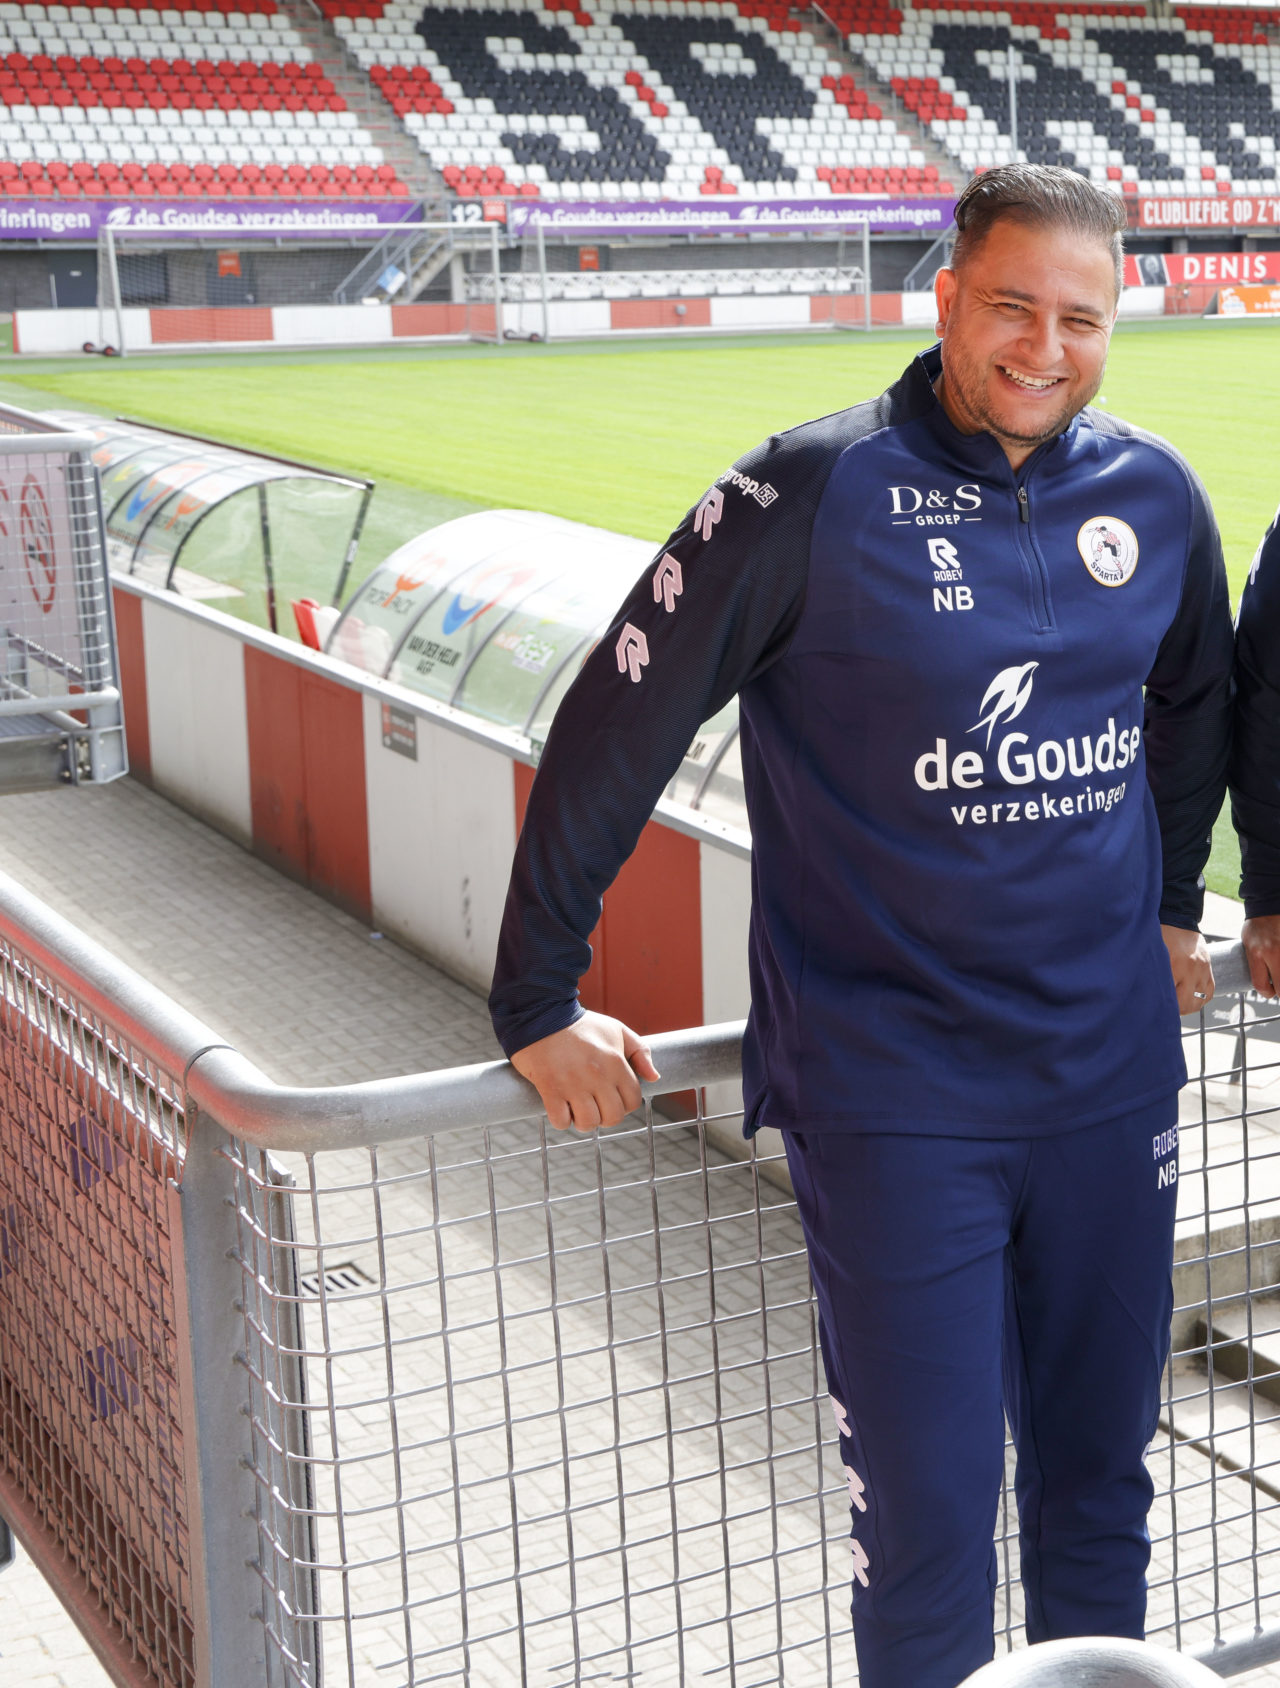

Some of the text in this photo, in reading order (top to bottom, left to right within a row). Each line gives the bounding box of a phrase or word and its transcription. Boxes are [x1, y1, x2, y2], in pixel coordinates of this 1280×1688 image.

[134, 208, 160, 226] de
[162, 208, 238, 225] Goudse
[453, 203, 482, 223] 12
[1143, 200, 1229, 225] CLUBLIEFDE
[1233, 200, 1253, 224] OP
[1183, 254, 1267, 281] DENIS
[887, 484, 982, 515] D&S
[915, 514, 961, 526] GROEP
[933, 568, 963, 582] ROBEY
[1090, 561, 1119, 582] SPARTA
[932, 585, 975, 612] NB
[914, 717, 1140, 791] de Goudse
[950, 781, 1126, 825] verzekeringen
[1157, 1159, 1178, 1190] NB
